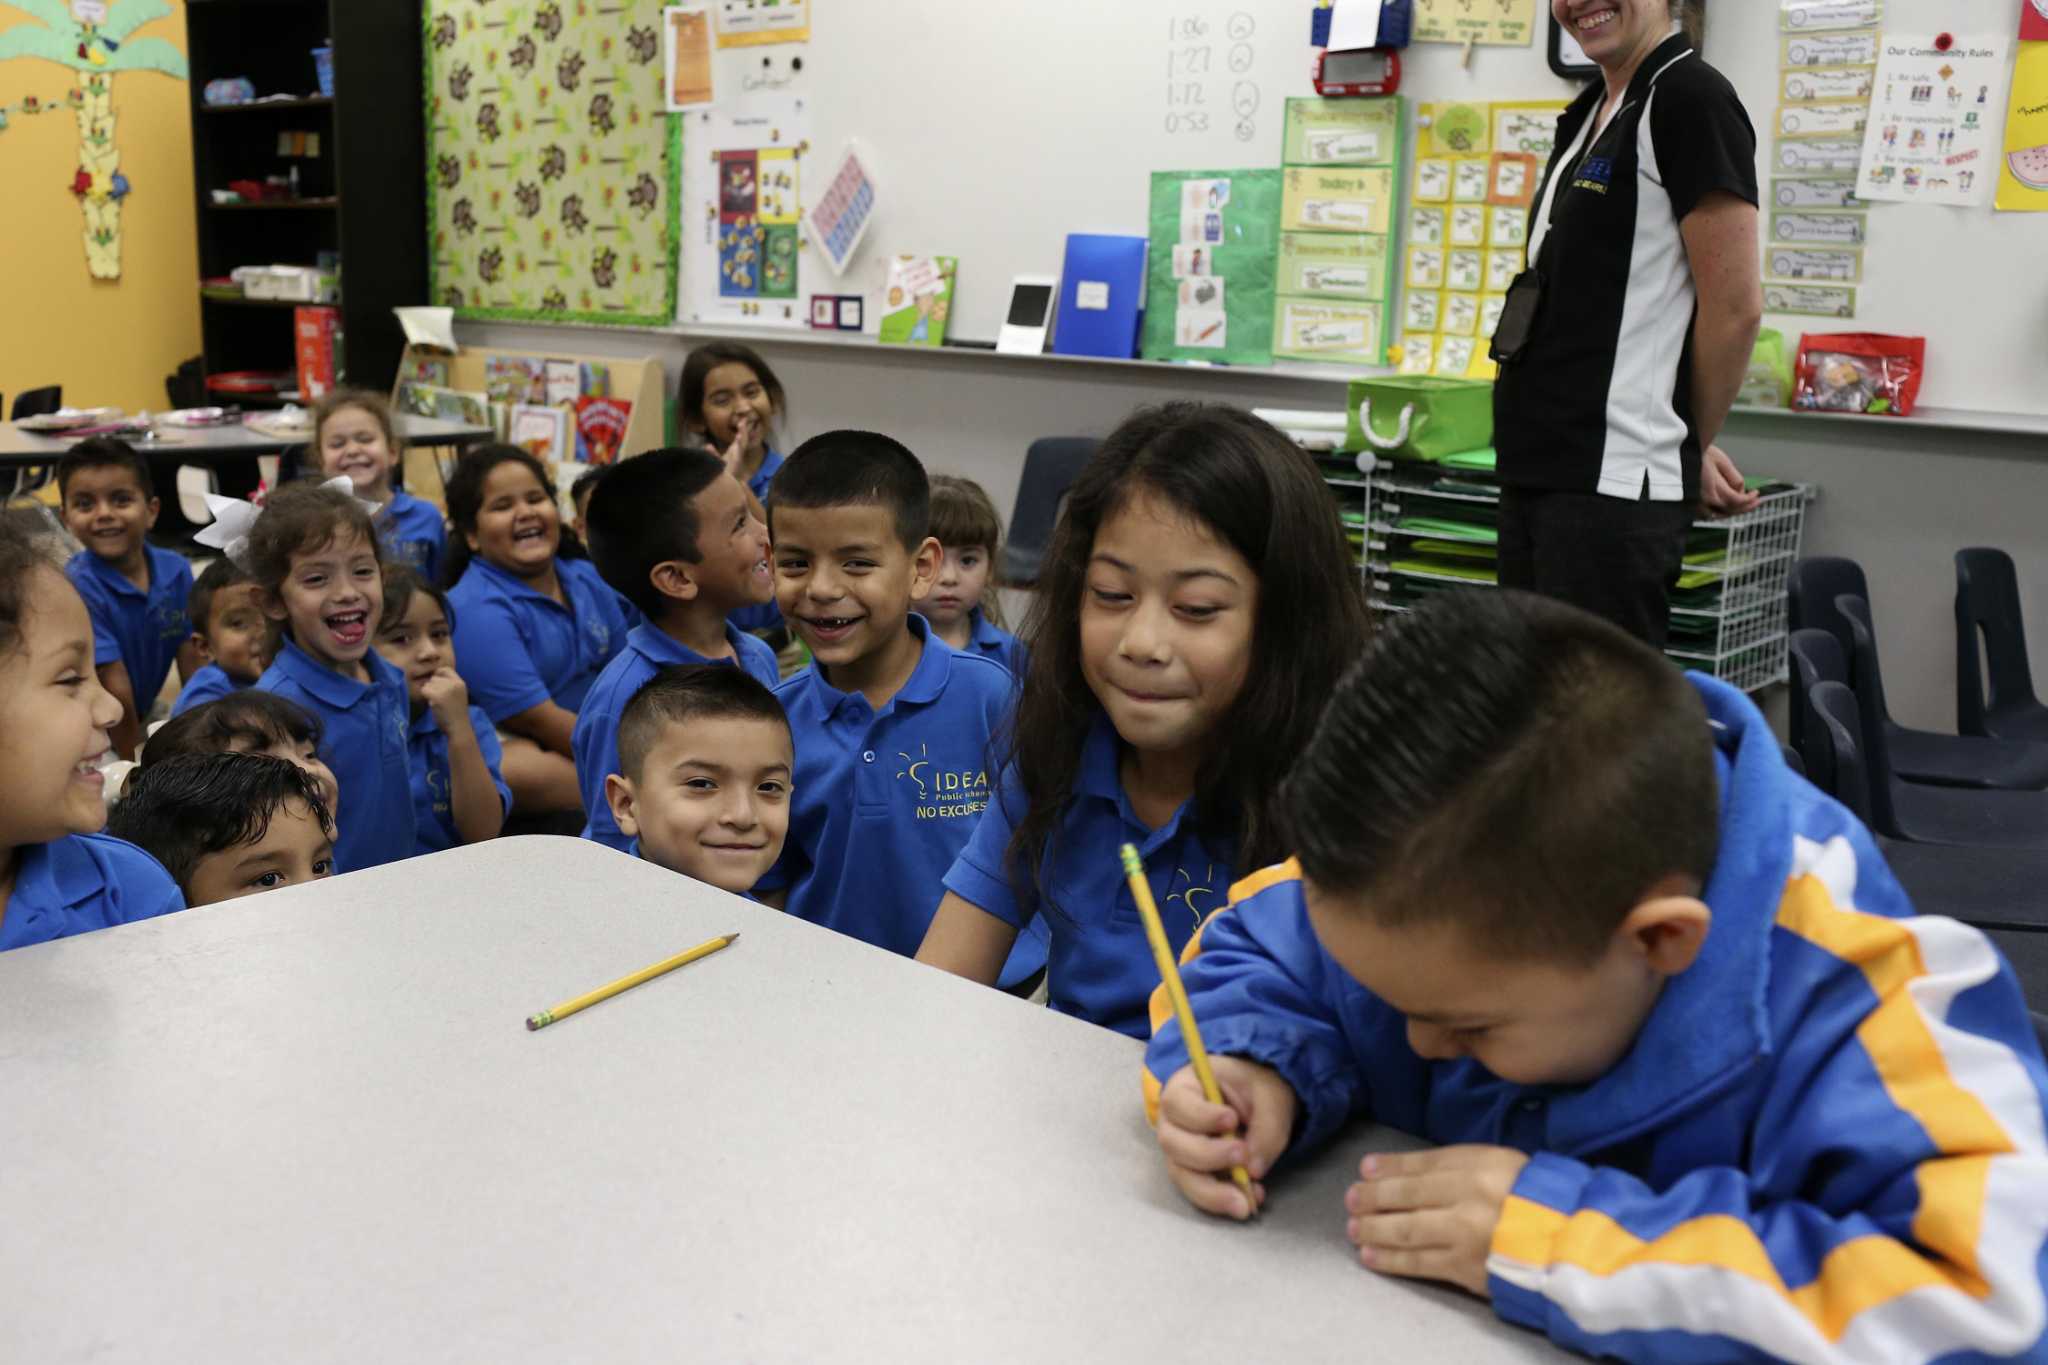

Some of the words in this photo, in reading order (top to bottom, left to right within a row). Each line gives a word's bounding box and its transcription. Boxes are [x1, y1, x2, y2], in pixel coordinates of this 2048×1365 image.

[1888, 47, 1906, 56] Our
[1969, 49, 1994, 58] Rules
[936, 771, 988, 792] IDEA
[936, 792, 965, 801] Public
[916, 806, 936, 819] NO
[939, 801, 988, 817] EXCUSES
